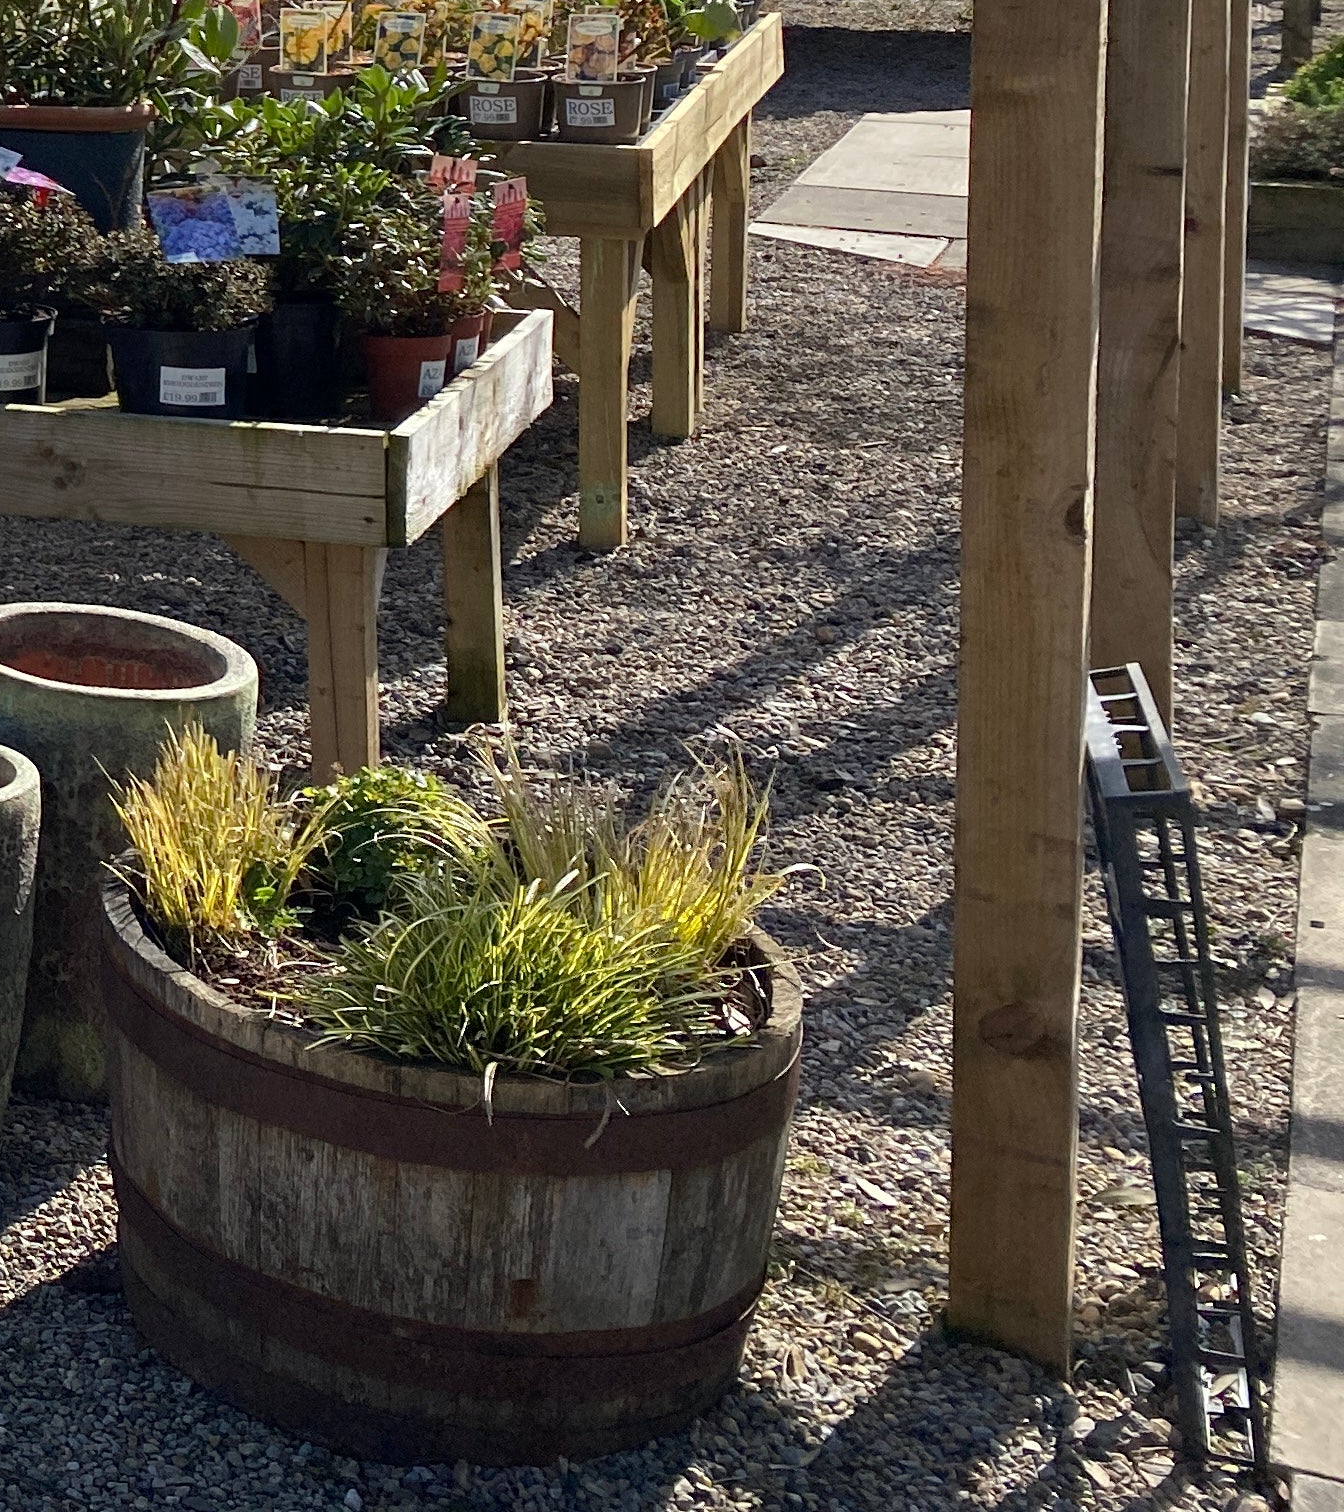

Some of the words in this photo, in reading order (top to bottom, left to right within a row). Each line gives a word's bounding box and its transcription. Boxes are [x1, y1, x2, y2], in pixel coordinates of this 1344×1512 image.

[472, 98, 515, 112] ROSE
[568, 101, 613, 115] ROSE
[163, 392, 198, 402] £19.99
